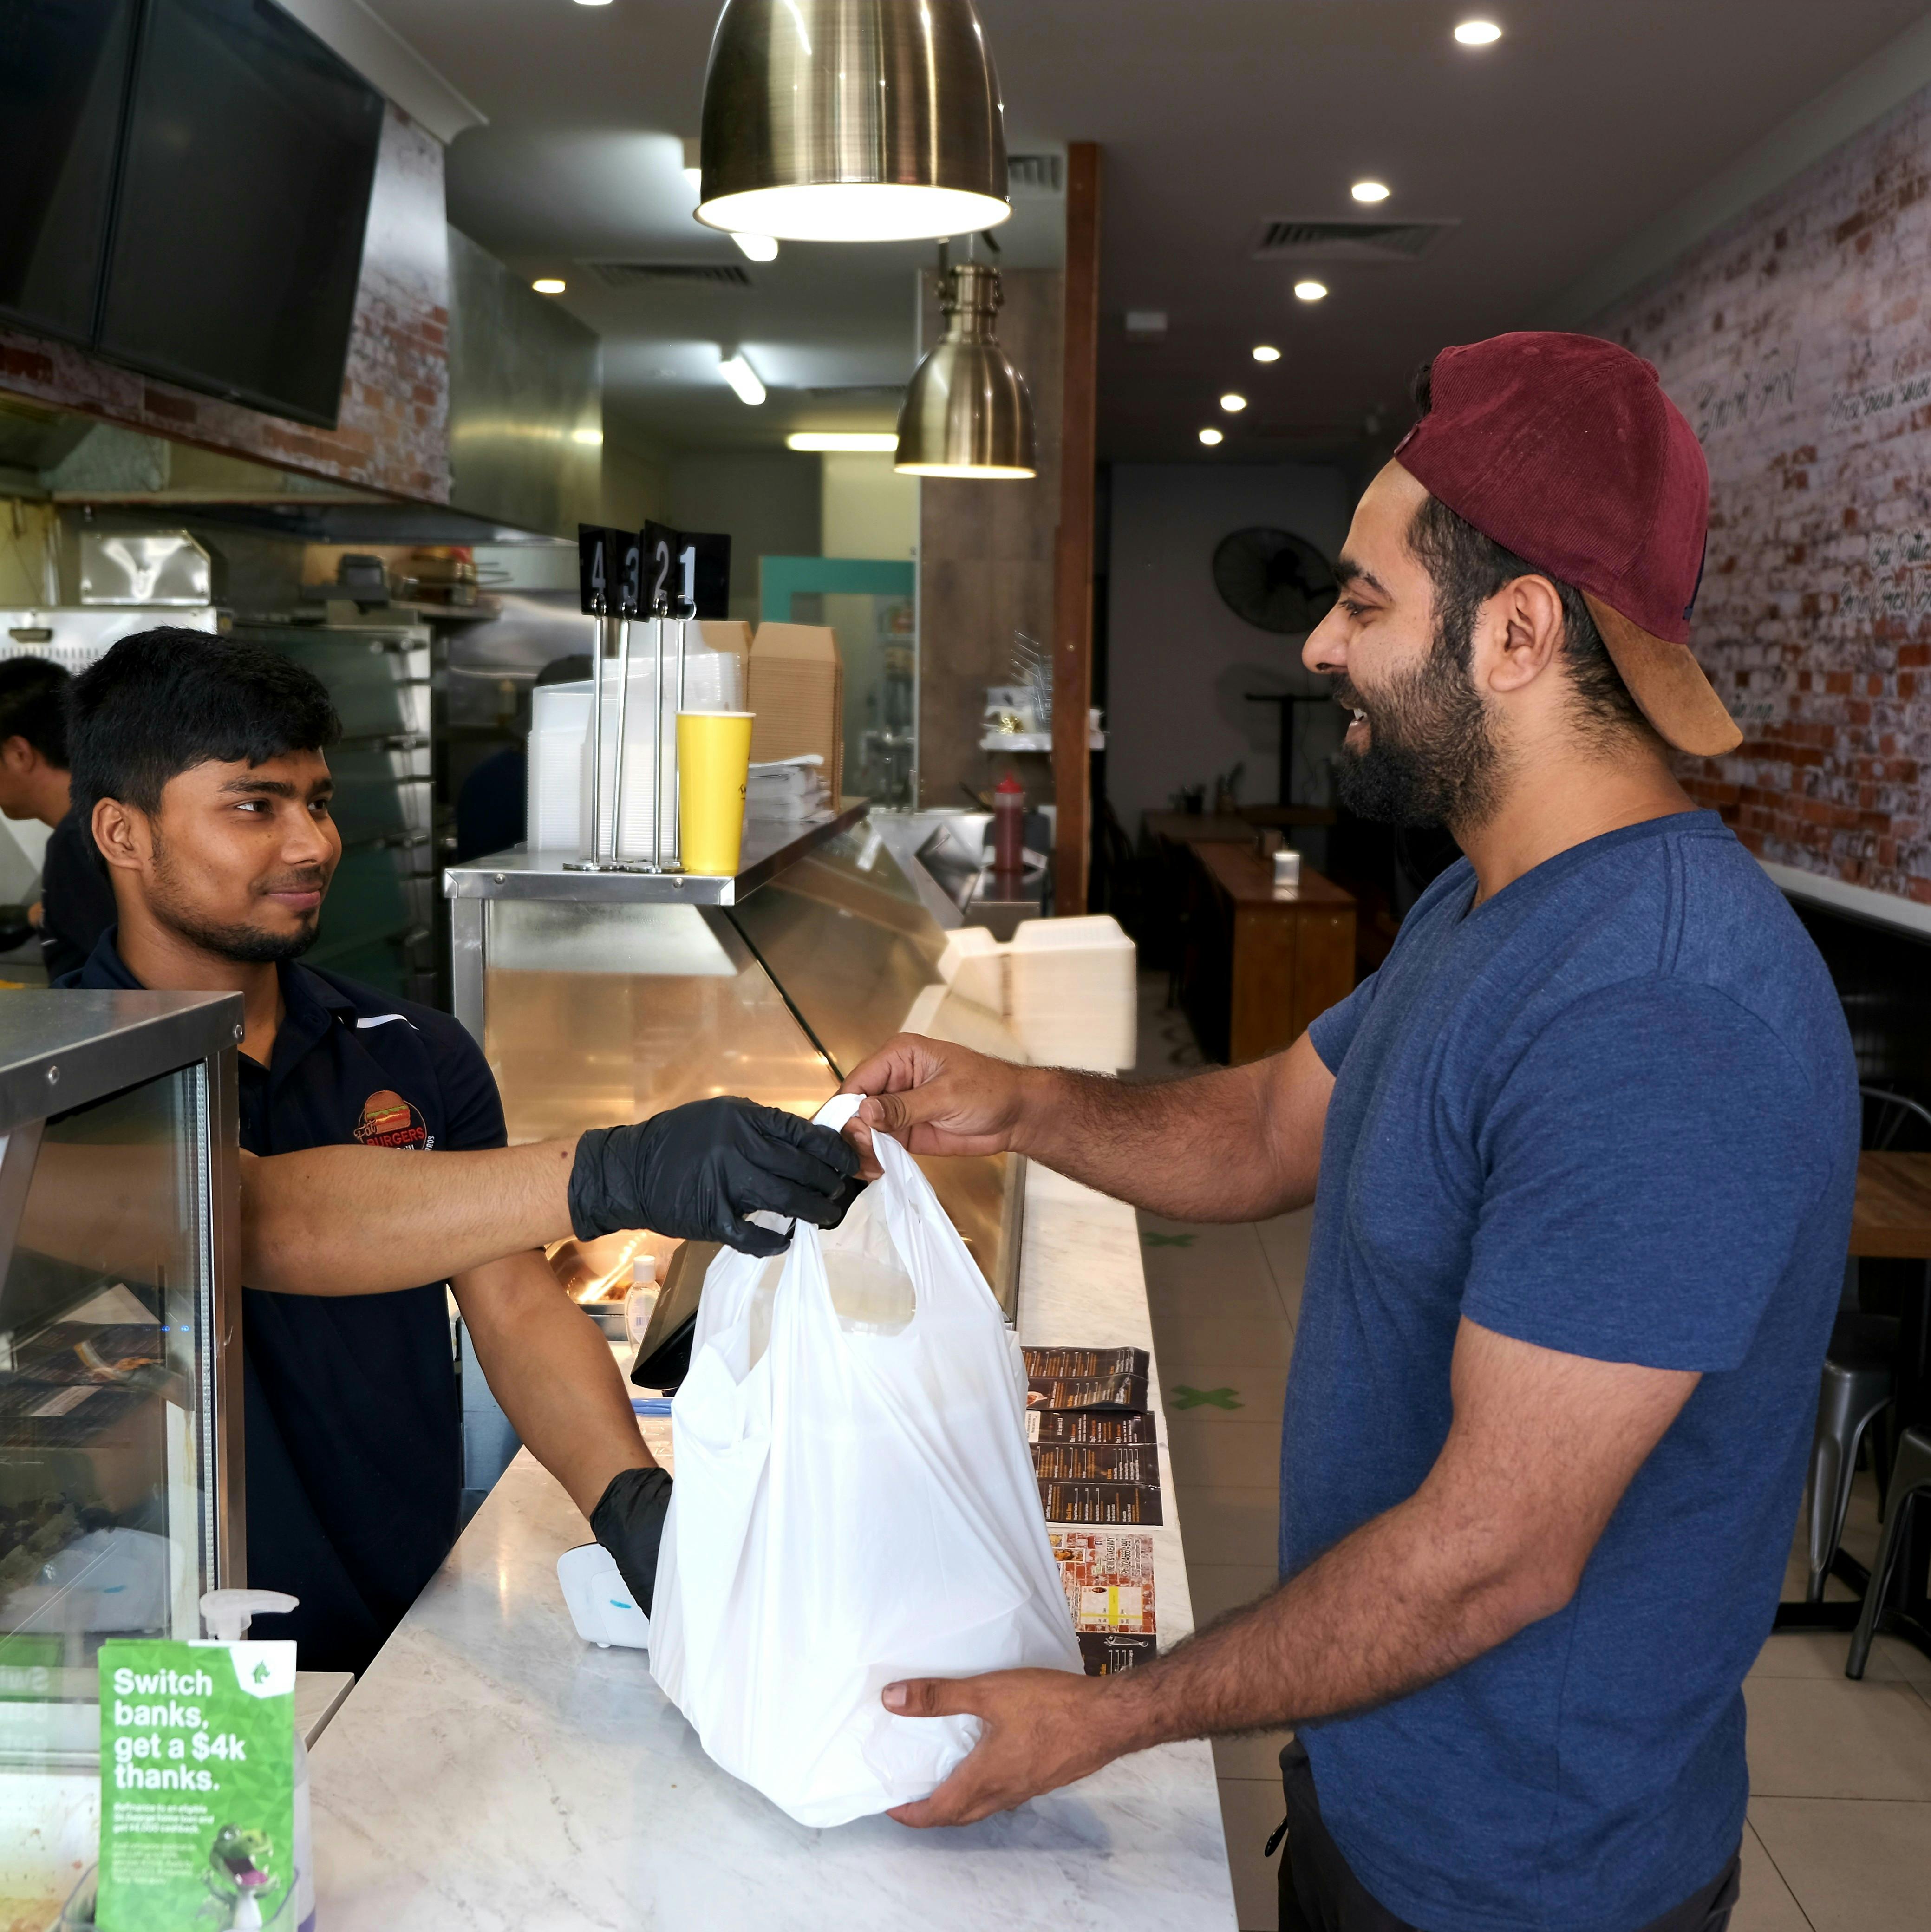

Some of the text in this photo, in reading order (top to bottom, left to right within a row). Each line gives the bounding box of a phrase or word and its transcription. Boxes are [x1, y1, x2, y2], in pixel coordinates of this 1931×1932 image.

[592, 541, 606, 600] 4
[623, 547, 639, 605] 3
[654, 540, 669, 601] 2
[680, 546, 695, 604] 1
[367, 1127, 425, 1147] BURGERS
[1106, 1538, 1115, 1556] TAKEAWAY
[114, 1667, 212, 1696] Switch
[115, 1699, 209, 1730] banks,
[114, 1730, 247, 1764] get a $4k
[114, 1762, 220, 1791] thanks.
